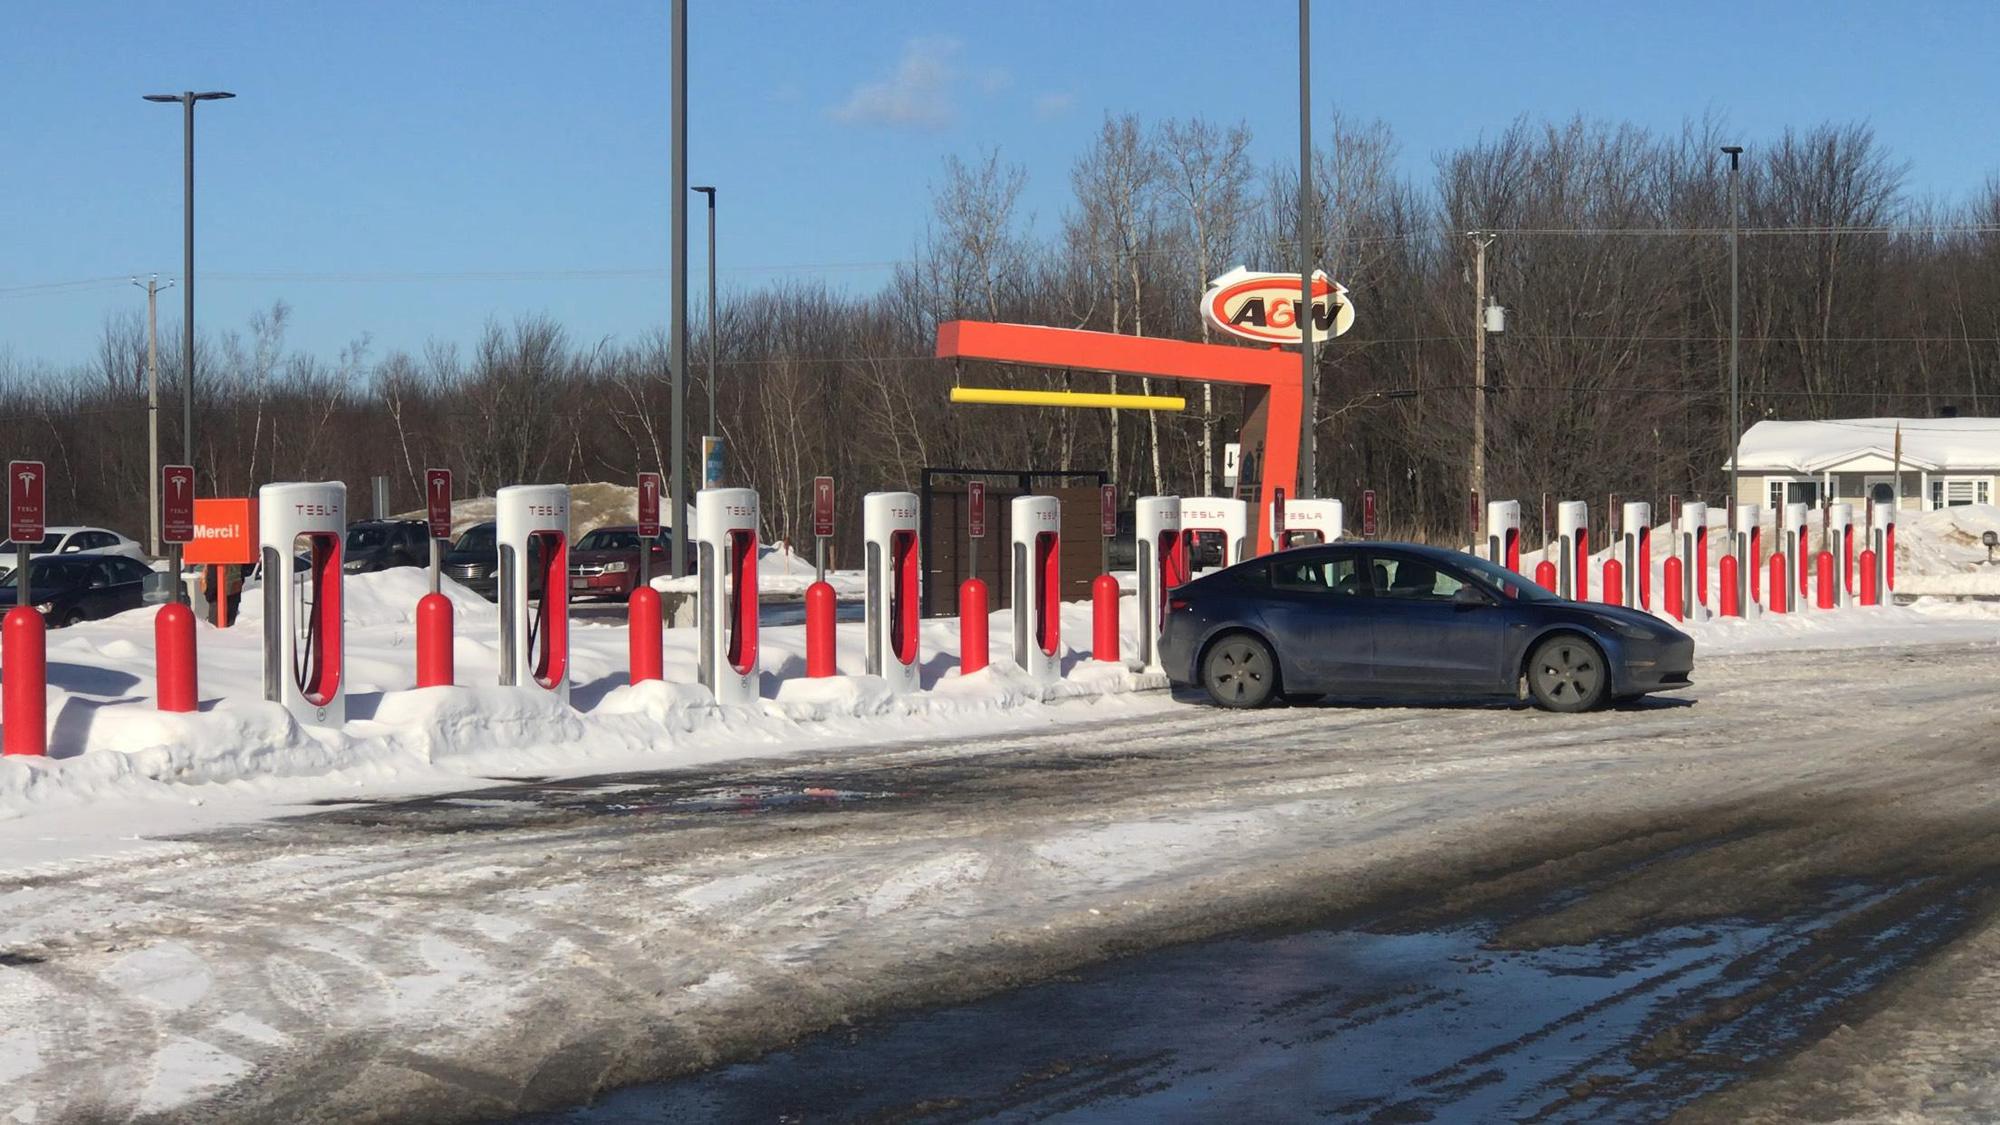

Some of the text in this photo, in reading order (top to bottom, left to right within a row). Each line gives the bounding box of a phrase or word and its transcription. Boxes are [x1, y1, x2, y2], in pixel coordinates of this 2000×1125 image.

[1229, 297, 1344, 331] A&W
[296, 505, 338, 516] TESLA
[529, 505, 564, 516] TESLA
[1182, 511, 1225, 519] TESLA
